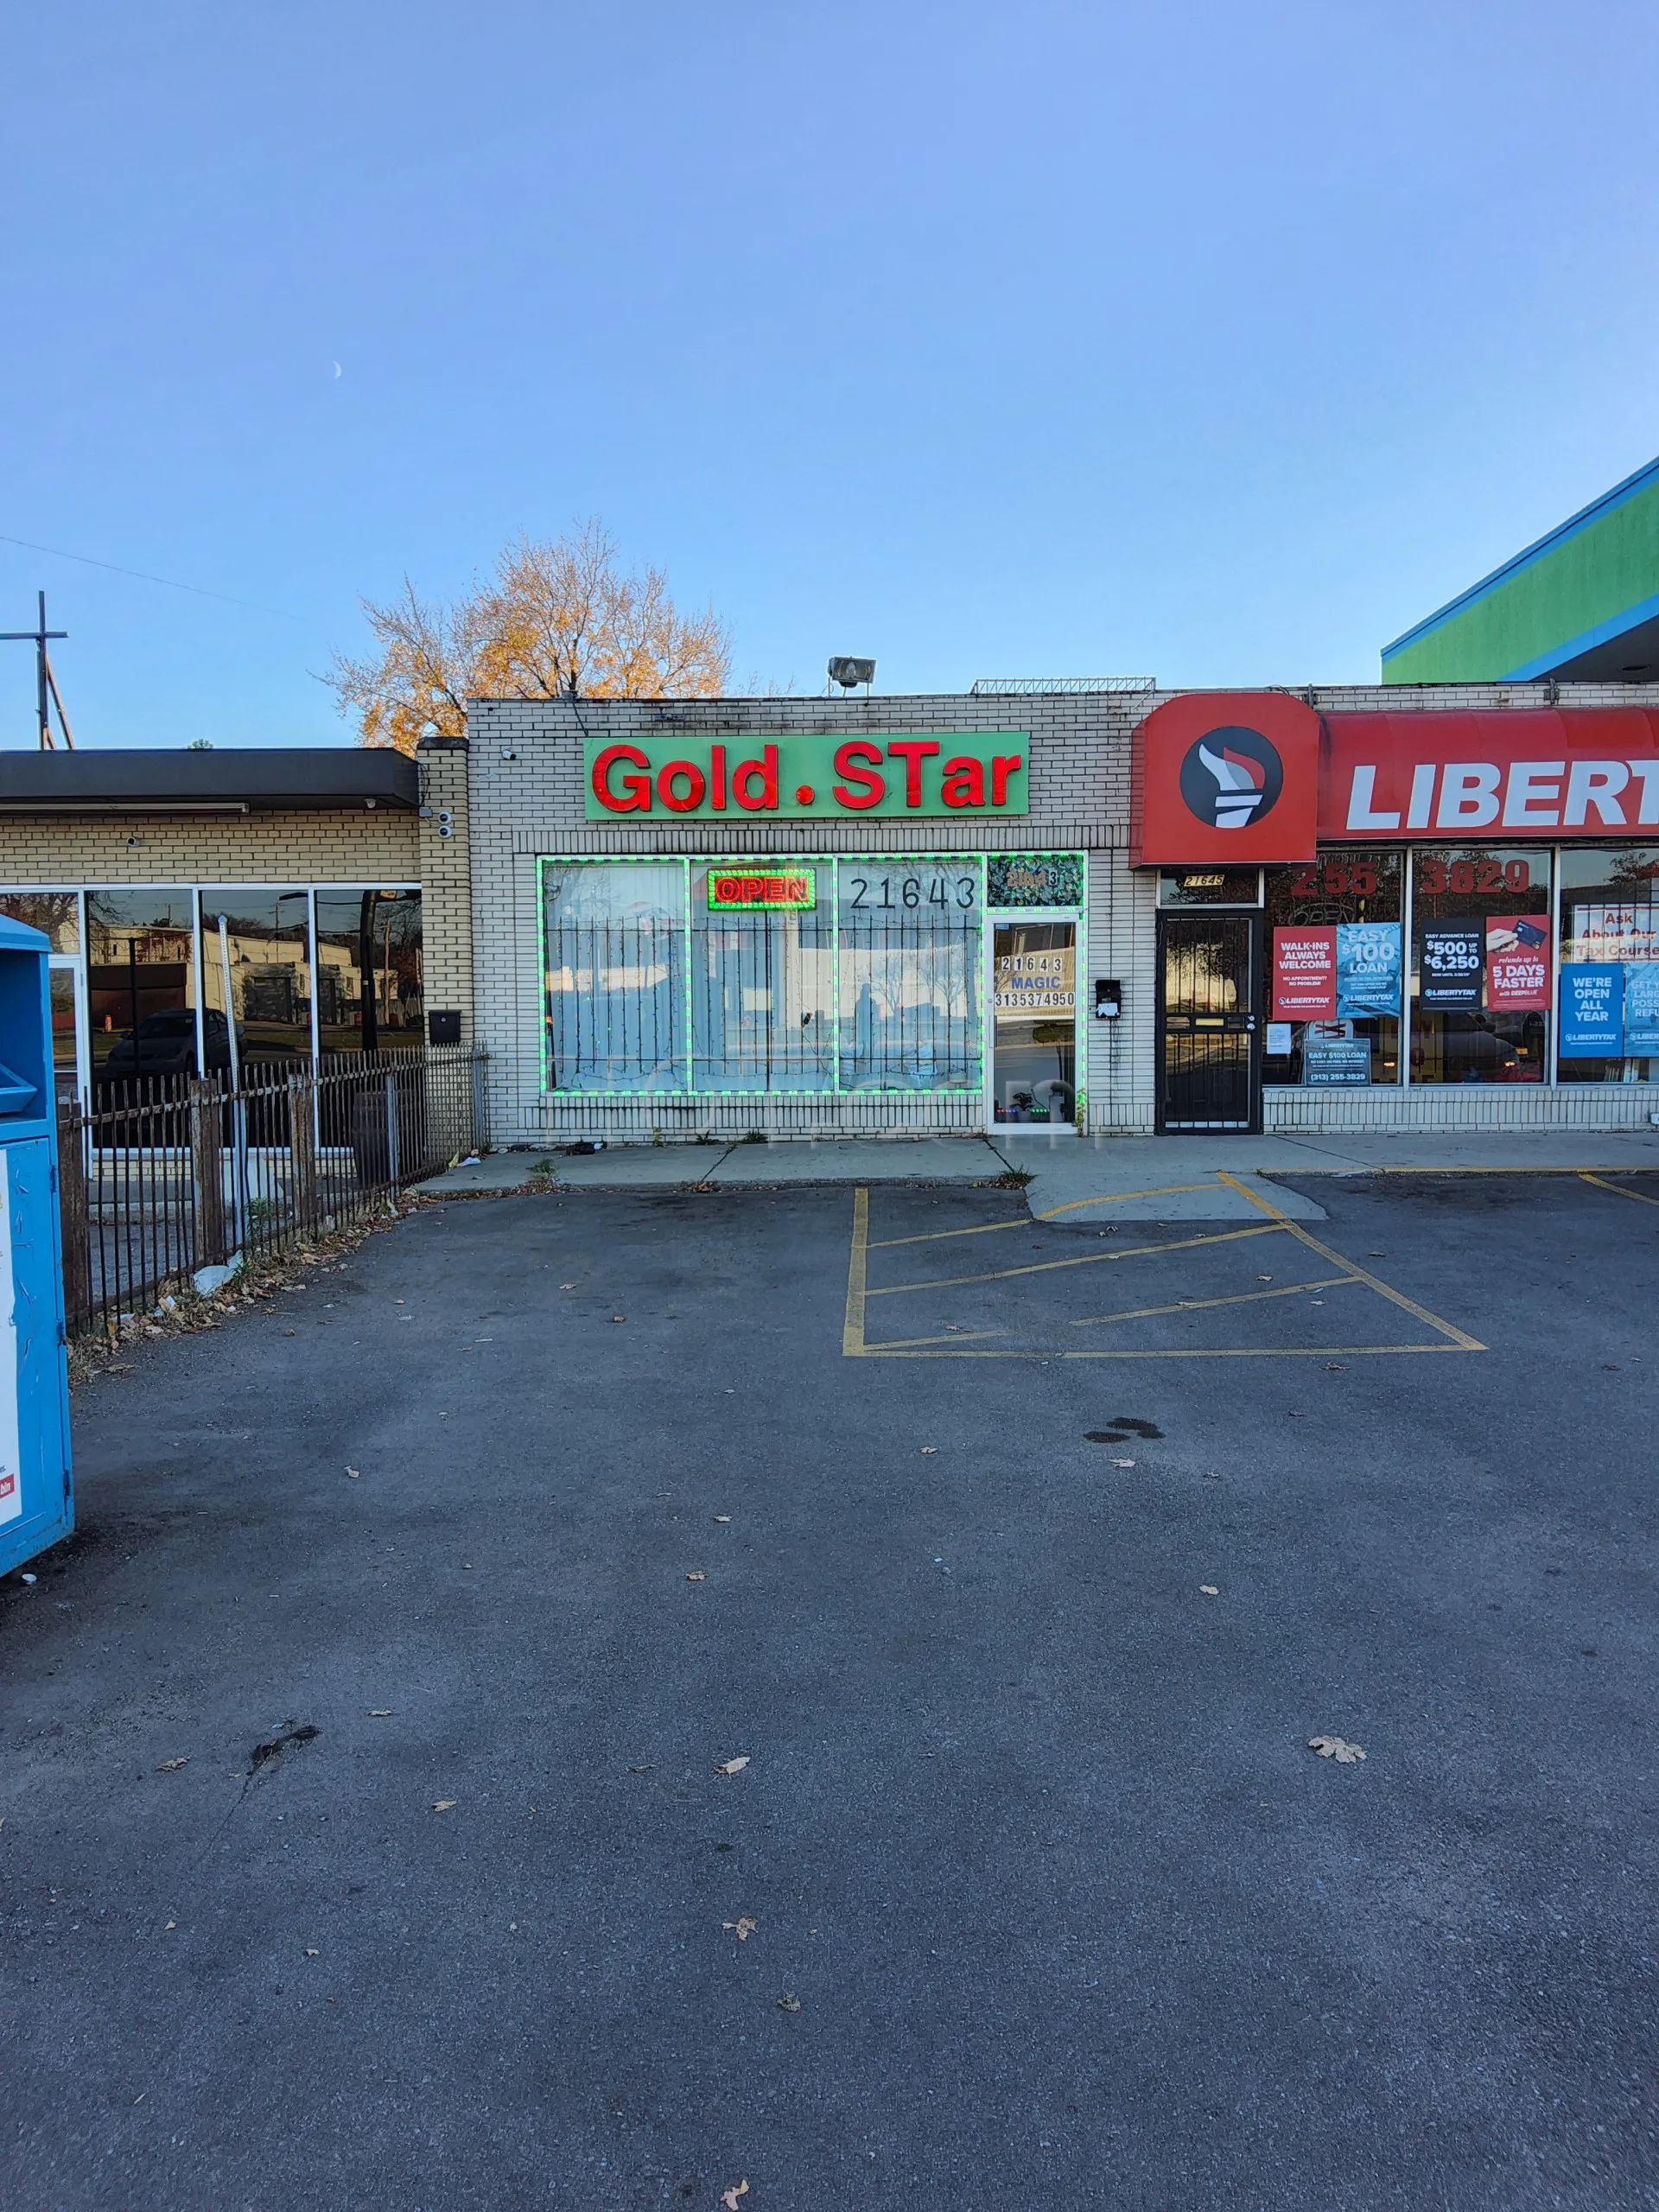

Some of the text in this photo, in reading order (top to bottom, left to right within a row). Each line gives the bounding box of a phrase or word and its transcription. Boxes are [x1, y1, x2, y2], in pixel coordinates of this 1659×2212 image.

[592, 744, 779, 814] Gold
[832, 741, 1022, 810] STar
[1185, 874, 1224, 886] 21645
[1290, 861, 1376, 897] 255
[1422, 859, 1529, 895] 3829
[714, 874, 810, 905] OPEN
[849, 877, 976, 910] 21643
[1605, 912, 1633, 925] Ask
[1347, 930, 1388, 943] EASY
[1581, 928, 1657, 940] About Our
[1280, 941, 1330, 951] WALK-INS
[1341, 942, 1395, 962] $100
[1426, 939, 1467, 956] $500
[1576, 944, 1605, 957] Tax
[1284, 951, 1326, 960] ALWAYS
[1002, 957, 1063, 971] 21643
[1279, 960, 1332, 969] WELCOME
[1349, 963, 1388, 974] LOAN
[1424, 954, 1479, 971] $6,250
[1492, 964, 1545, 977] 5 DAYS
[1011, 976, 1062, 990] MAGIC
[1573, 976, 1612, 988] WE'RE
[1630, 981, 1651, 989] GET
[995, 993, 1075, 1007] 3135374950
[1573, 988, 1610, 999] OPEN
[1580, 1000, 1604, 1010] ALL
[1574, 1011, 1609, 1022] YEAR
